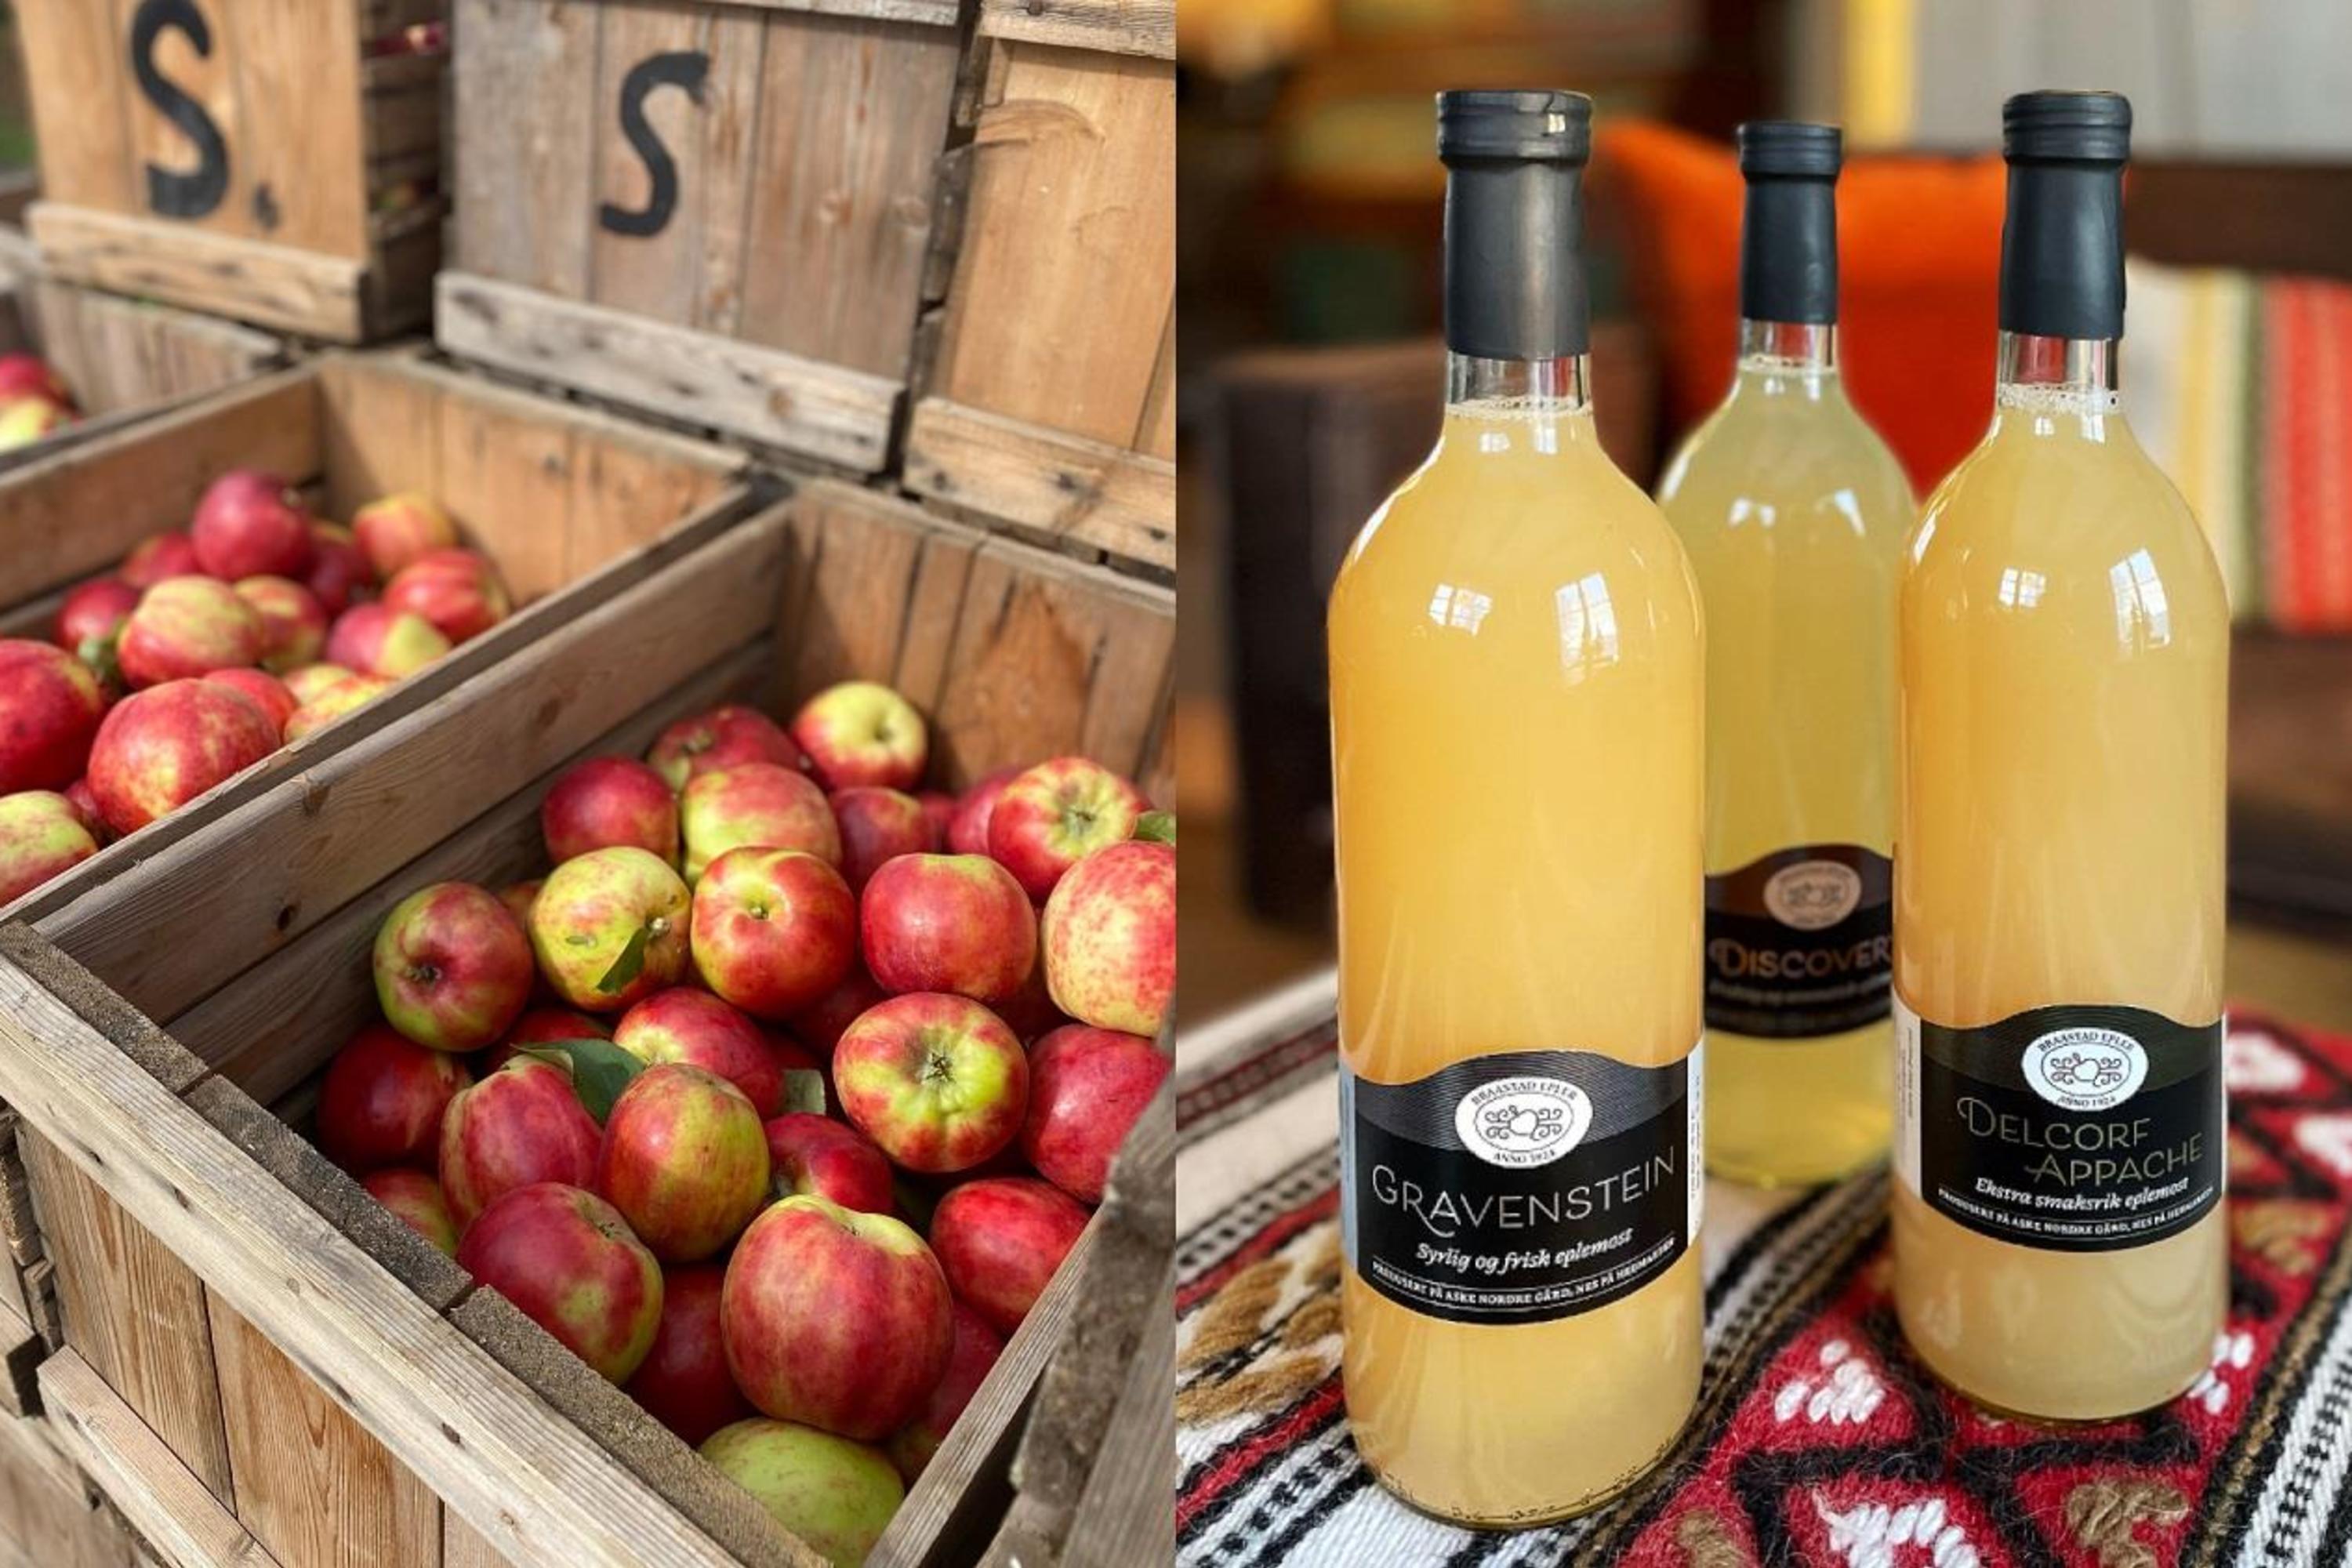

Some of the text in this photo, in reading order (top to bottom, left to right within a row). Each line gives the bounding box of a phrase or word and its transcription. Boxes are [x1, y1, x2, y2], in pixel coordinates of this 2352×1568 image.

[599, 52, 710, 237] S
[1709, 935, 1892, 978] DISCOVER
[1957, 1098, 2151, 1151] DELCORF
[2024, 1134, 2202, 1187] APPACHE
[1372, 1146, 1675, 1238] GRAVENSTEIN
[1975, 1177, 2189, 1210] Ekstra smaksrik eplemost
[1416, 1227, 1635, 1276] Syrlig og frisk eplemost
[1429, 1284, 1443, 1298] PÅ
[1446, 1290, 1476, 1304] ASKE
[1478, 1292, 1532, 1305] NORDRE
[1575, 1279, 1599, 1294] NES
[1601, 1272, 1615, 1288] PÅ
